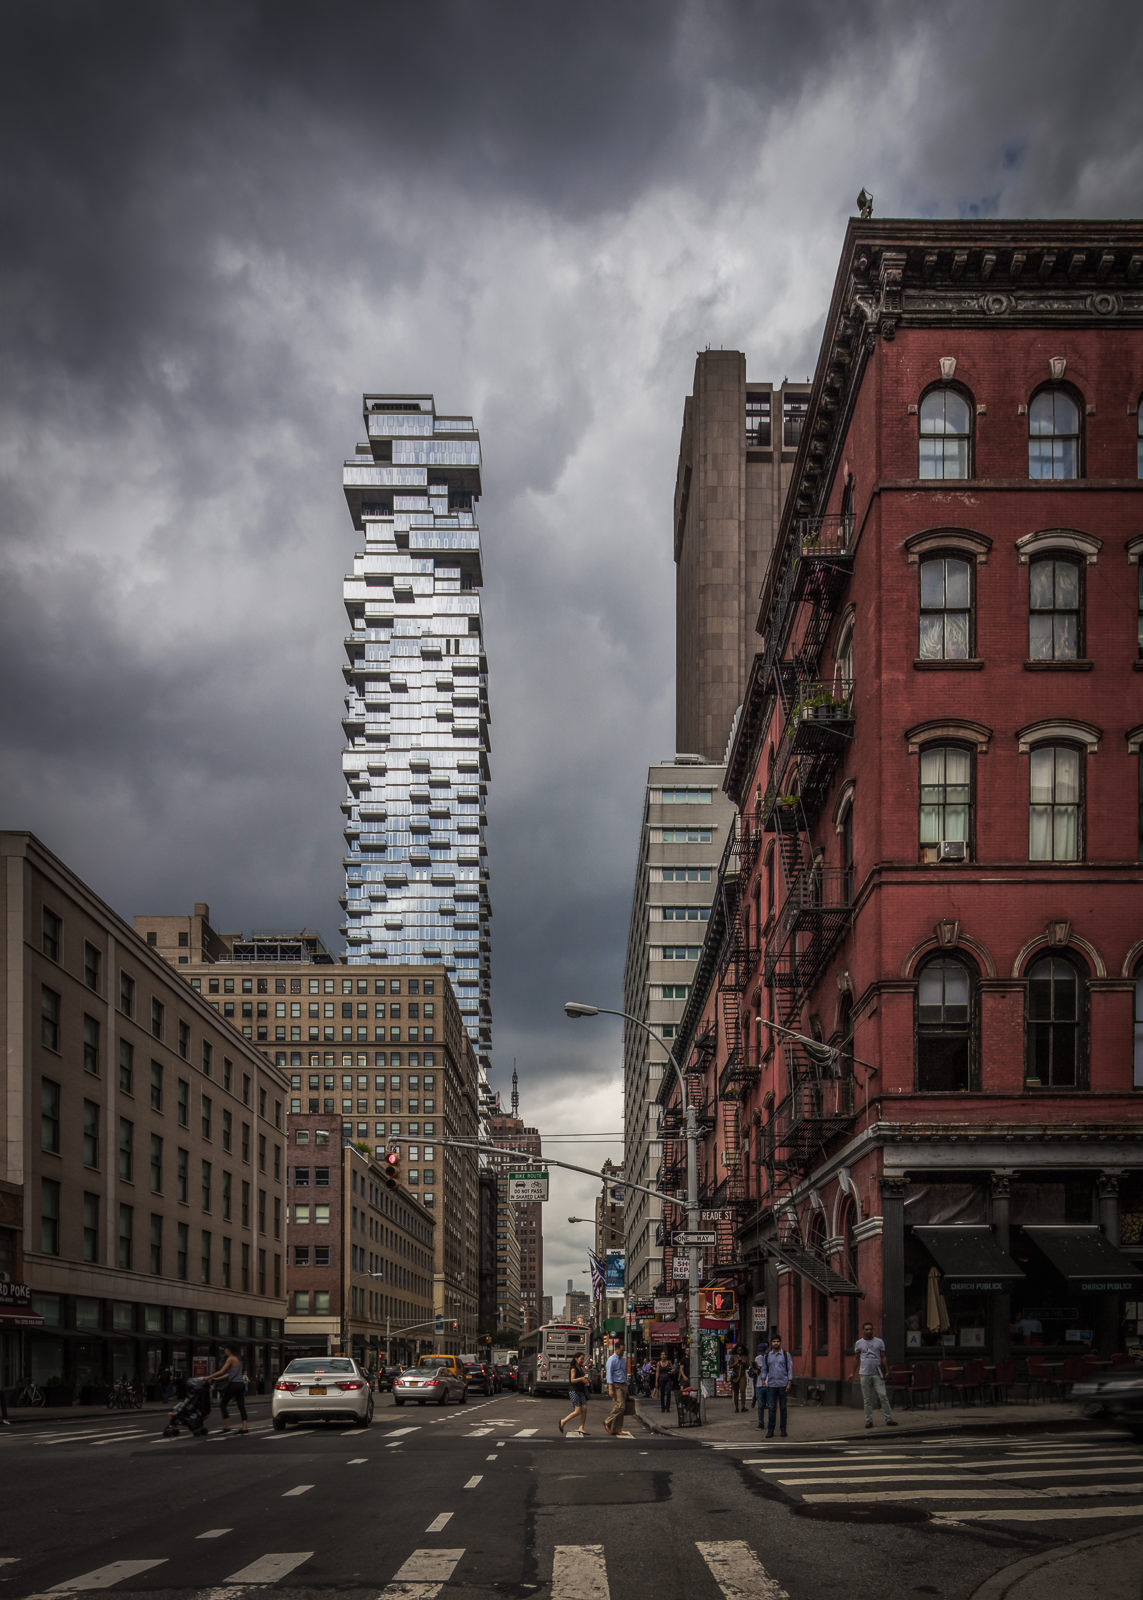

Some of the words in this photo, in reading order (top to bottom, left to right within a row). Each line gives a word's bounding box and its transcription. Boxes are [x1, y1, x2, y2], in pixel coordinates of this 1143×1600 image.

[701, 1211, 722, 1220] READE
[724, 1211, 732, 1220] ST
[10, 1284, 31, 1298] POKE
[910, 1335, 917, 1344] A
